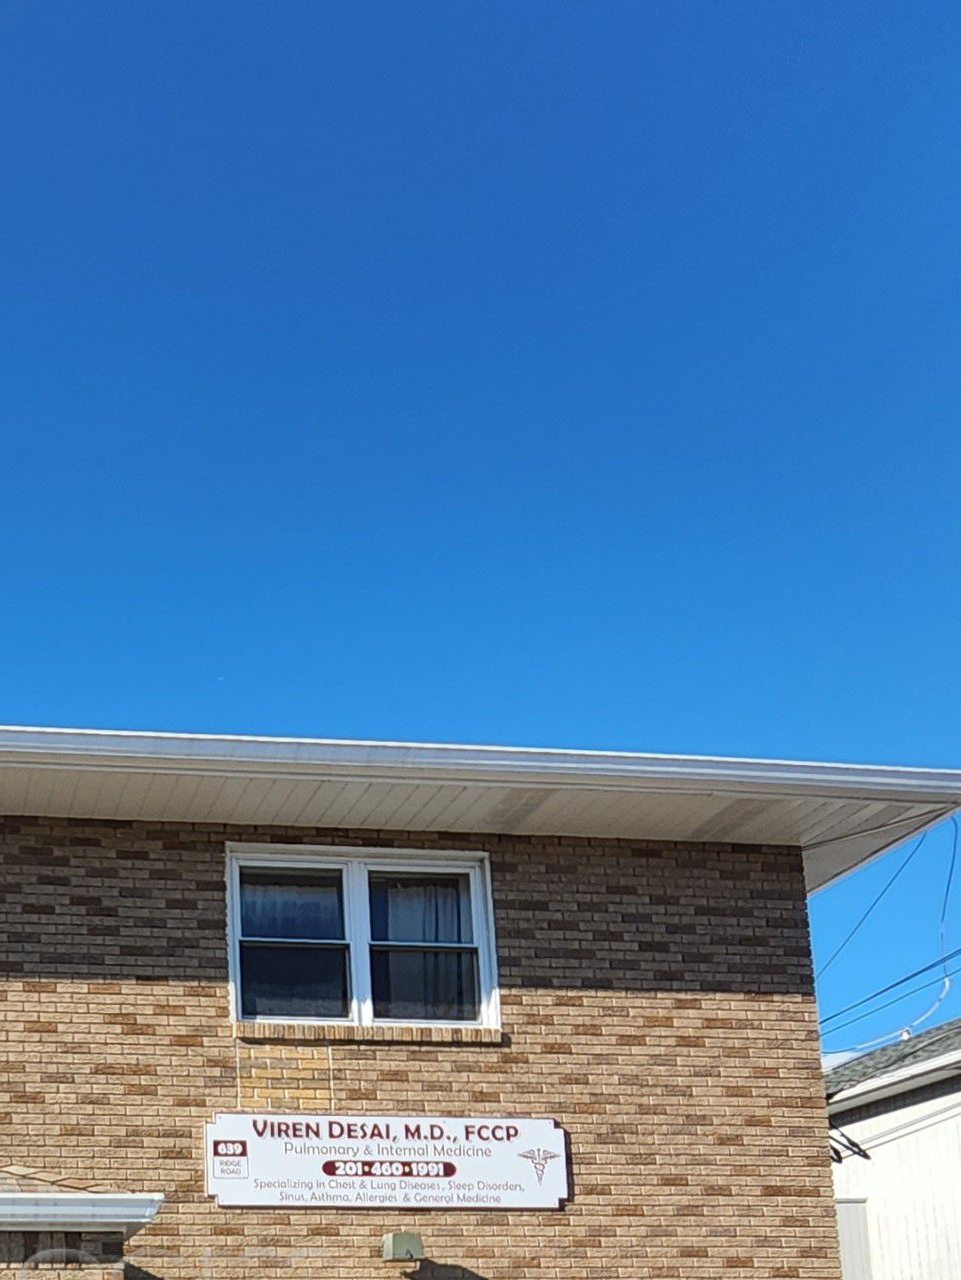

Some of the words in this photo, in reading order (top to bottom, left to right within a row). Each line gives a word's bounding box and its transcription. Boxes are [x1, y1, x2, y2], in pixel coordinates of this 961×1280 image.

[404, 1123, 458, 1143] M.D.,
[464, 1124, 520, 1141] FCCP
[217, 1142, 243, 1155] 639
[284, 1142, 360, 1158] Pulmonary
[363, 1144, 373, 1156] &
[377, 1143, 429, 1157] Internal
[433, 1144, 492, 1158] Medicine
[219, 1159, 242, 1167] RIDGE
[220, 1168, 242, 1176] ROAD
[253, 1178, 314, 1190] Specializing
[328, 1178, 355, 1190] Chest
[358, 1180, 368, 1189] &
[370, 1180, 397, 1191] Lung
[447, 1180, 475, 1192] Sleep
[477, 1181, 525, 1192] Disorders,
[310, 1191, 352, 1203] Asthma,
[355, 1192, 397, 1204] Allergies
[402, 1193, 412, 1202] &
[414, 1193, 454, 1204] General
[457, 1194, 501, 1204] Medicine
